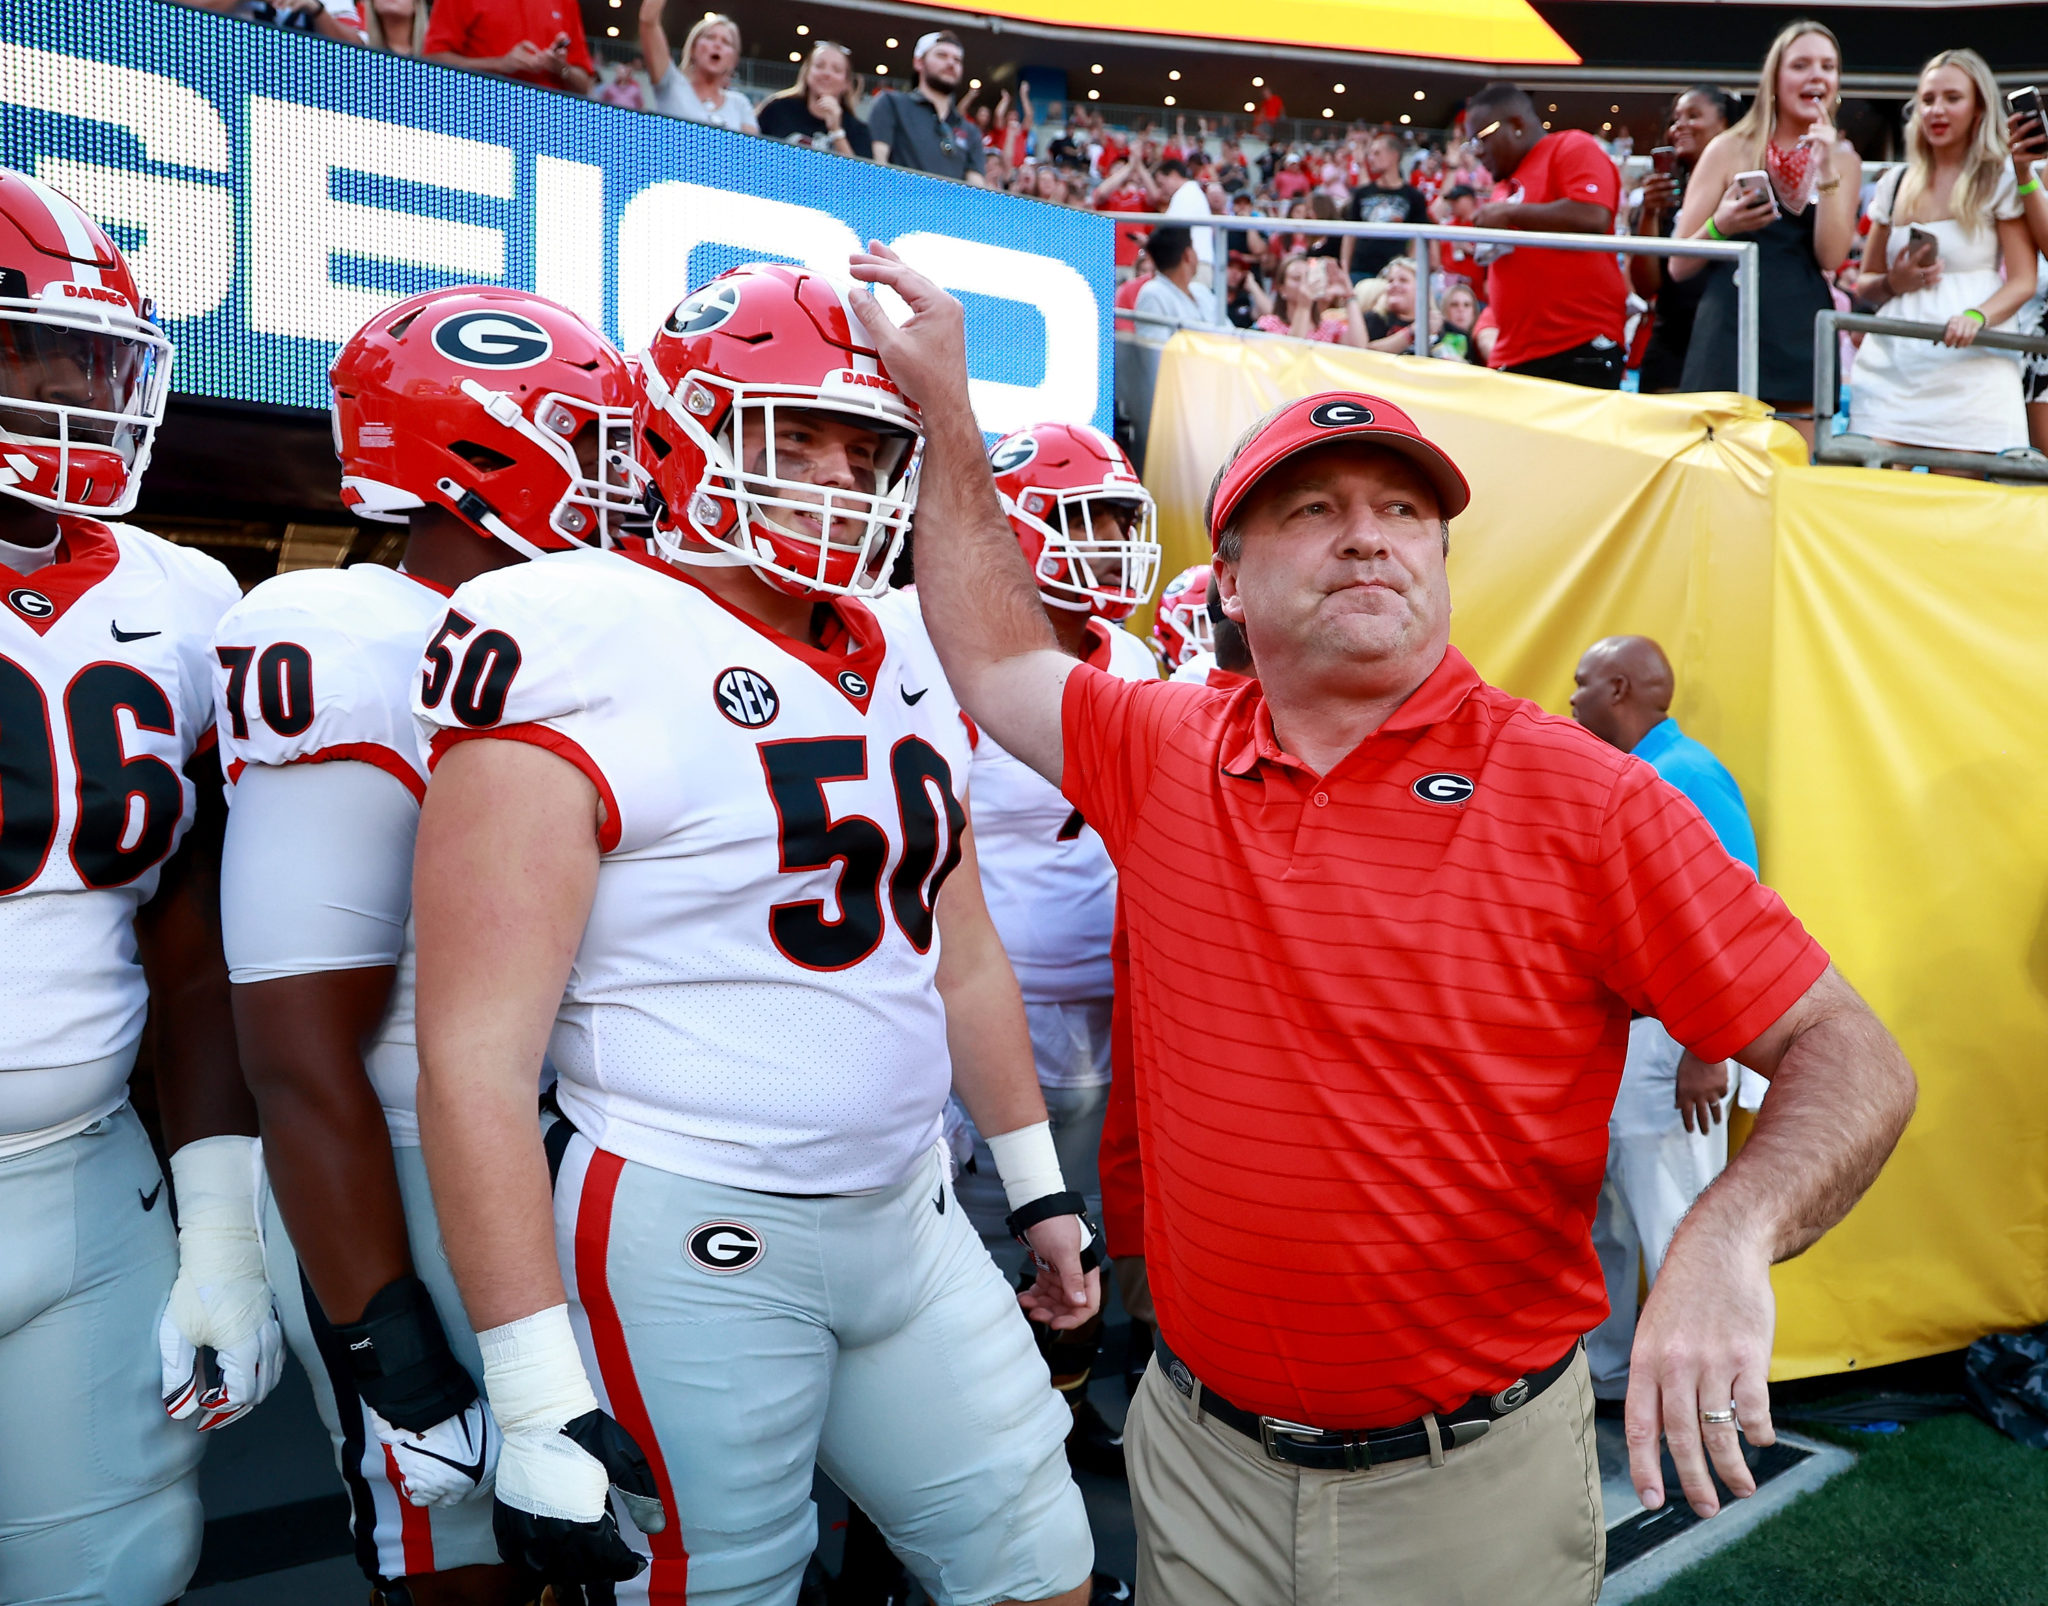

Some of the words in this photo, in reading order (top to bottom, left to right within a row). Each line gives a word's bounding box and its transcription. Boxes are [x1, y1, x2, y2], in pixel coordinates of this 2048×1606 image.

[63, 284, 127, 307] DAWGS
[435, 312, 549, 365] G
[1311, 401, 1373, 426] G
[10, 589, 53, 617] G
[421, 607, 522, 729] 50
[839, 671, 868, 697] G
[216, 641, 314, 739] 70
[717, 668, 777, 726] SEC
[1414, 773, 1474, 803] G
[756, 734, 967, 973] 50
[690, 1225, 759, 1268] G
